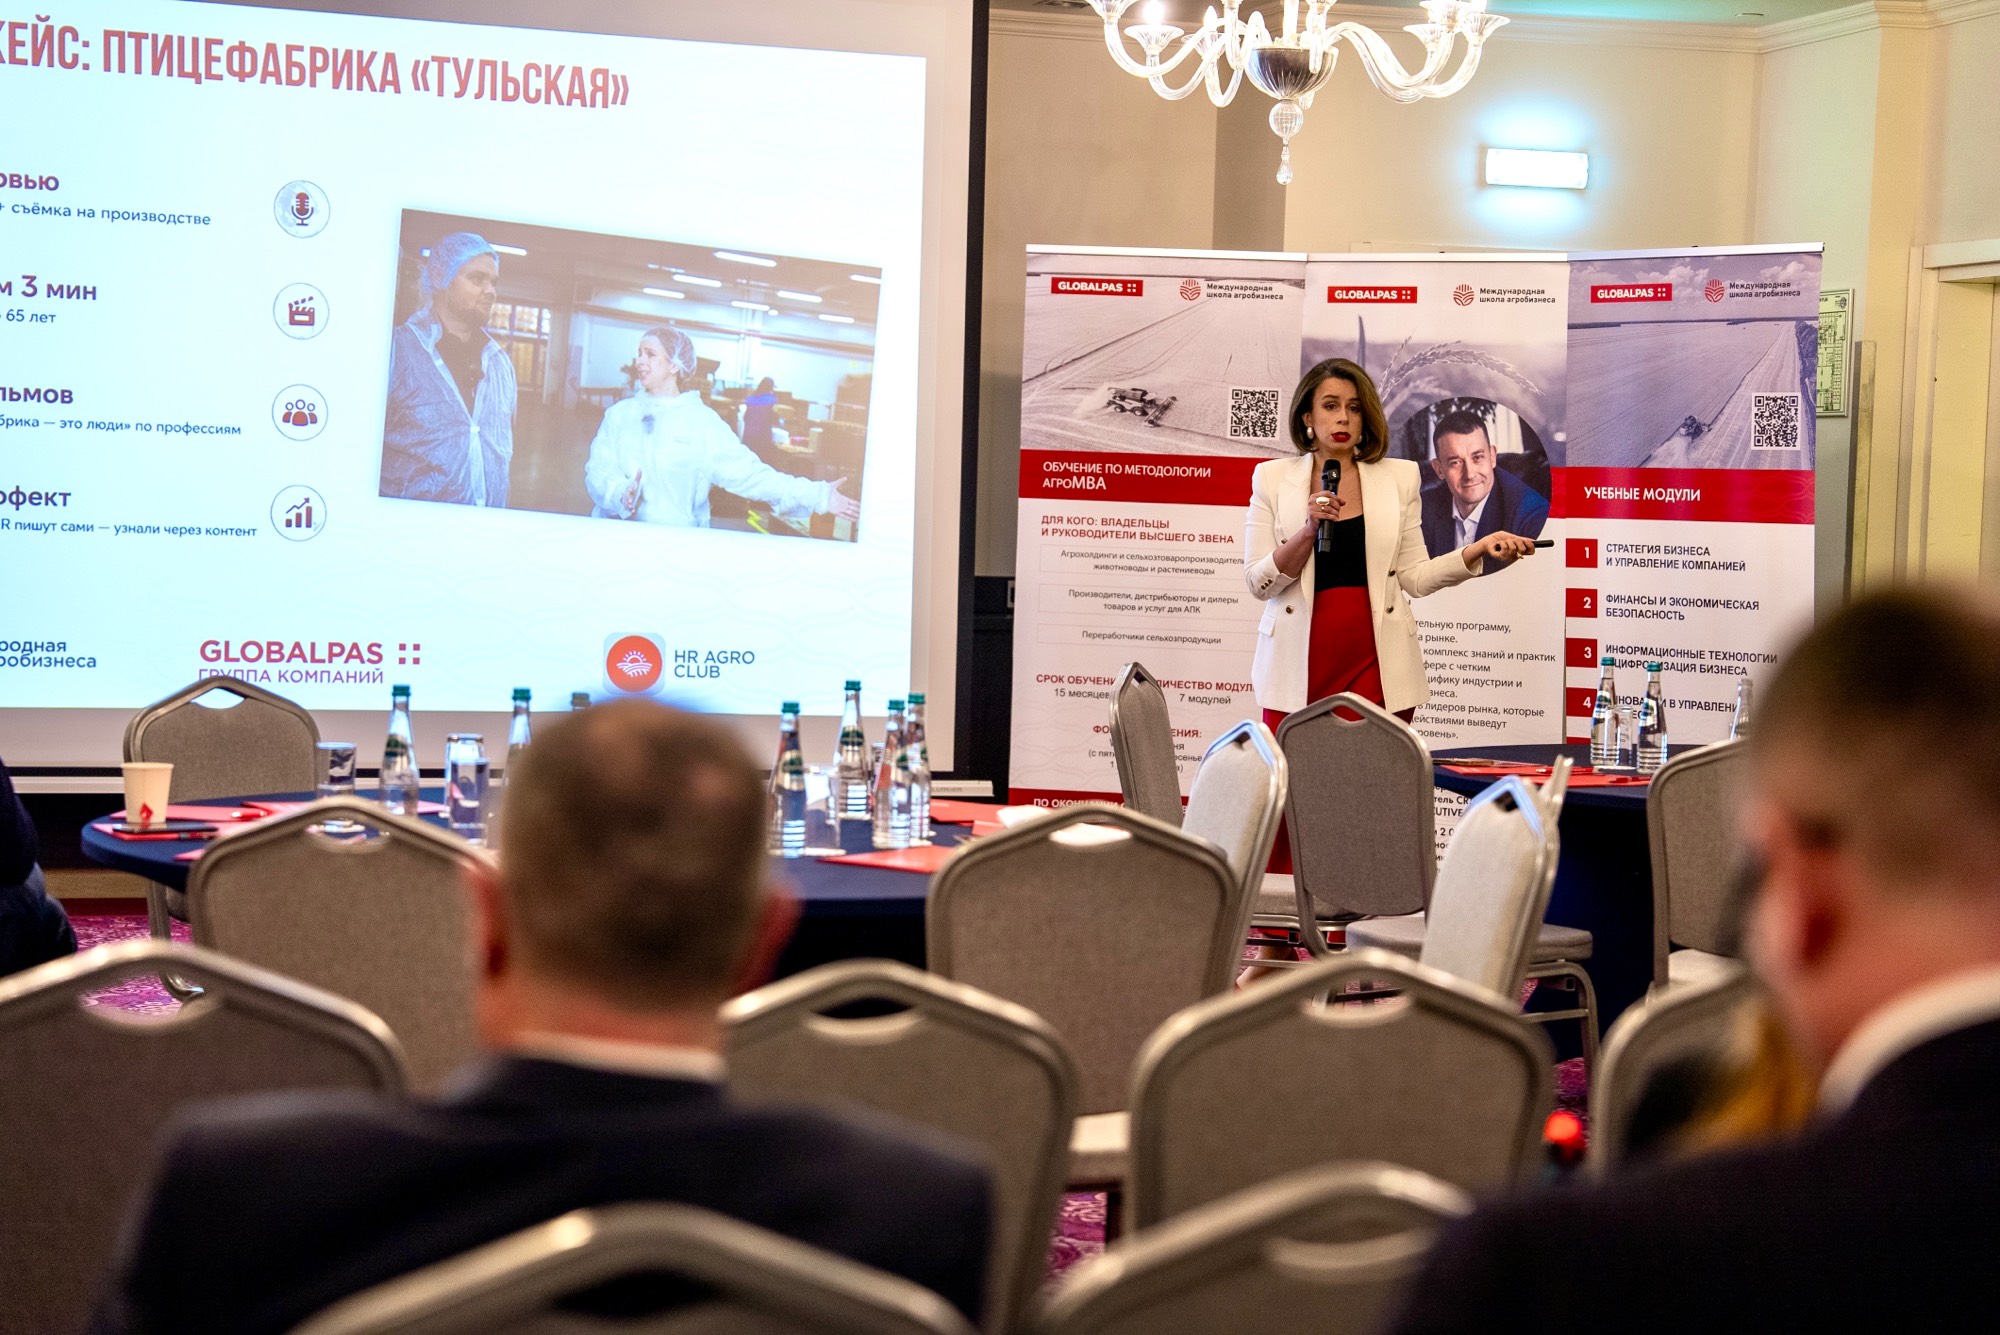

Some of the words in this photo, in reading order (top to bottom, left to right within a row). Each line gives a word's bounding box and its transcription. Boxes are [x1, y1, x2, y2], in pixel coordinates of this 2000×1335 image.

[0, 14, 90, 70] ЕЙС:
[103, 29, 401, 94] ПТИЦЕФАБРИКА
[411, 54, 630, 109] «ТУЛЬСКАЯ»
[11, 202, 72, 217] съёмка
[77, 207, 95, 218] на
[101, 210, 211, 225] производстве
[21, 274, 38, 297] 3
[46, 283, 97, 300] мин
[1057, 281, 1124, 293] GLOBALPAS
[1206, 283, 1273, 292] Международная
[1479, 287, 1545, 296] Международная
[1729, 281, 1791, 290] Международная
[1206, 291, 1232, 299] школа
[1234, 291, 1283, 300] агробизнеса
[1334, 290, 1398, 300] GLOBALPAS
[1507, 295, 1556, 304] агробизнеса
[1597, 288, 1654, 299] GLOBALPAS
[1754, 289, 1800, 298] агробизнеса
[6, 309, 25, 322] 65
[29, 313, 56, 323] лет
[59, 418, 83, 429] это
[86, 420, 131, 432] люди»
[135, 422, 152, 432] по
[156, 422, 241, 436] профессиям
[1042, 461, 1102, 474] ОБУЧЕНИЕ
[1105, 463, 1122, 474] ПО
[1124, 465, 1211, 478] МЕТОДОЛОГИИ
[1584, 486, 1640, 500] УЧЕБНЫЕ
[1643, 488, 1701, 503] МОДУЛИ
[1041, 515, 1063, 526] ДЛЯ
[1066, 516, 1098, 526] КОГО:
[1101, 518, 1169, 529] ВЛАДЕЛЬЦЫ
[15, 521, 56, 534] пишут
[61, 522, 94, 533] сами
[114, 524, 160, 536] узнали
[164, 525, 201, 537] через
[205, 525, 257, 537] контент
[1041, 528, 1048, 536] И
[1052, 529, 1136, 540] РУКОВОДИТЕЛИ
[1140, 532, 1195, 542] ВЫСШЕГО
[1198, 534, 1234, 544] ЗВЕНА
[1061, 550, 1117, 561] Агрохолдинги
[1584, 547, 1590, 559] 1
[1606, 543, 1661, 555] СТРАТЕГИЯ
[1663, 545, 1711, 556] БИЗНЕСА
[1093, 564, 1148, 573] животноводы
[1157, 566, 1215, 576] растениеводы
[1606, 558, 1613, 567] И
[1615, 558, 1679, 570] УПРАВЛЕНИЕ
[1682, 559, 1746, 571] КОМПАНИЕЙ
[1068, 589, 1133, 600] Производители,
[1134, 593, 1199, 603] дистрибьюторы
[1207, 596, 1239, 605] дилеры
[1583, 597, 1591, 609] 2
[1605, 594, 1657, 605] ФИНАНСЫ
[1659, 596, 1667, 605] И
[1669, 597, 1759, 611] ЭКОНОМИЧЕСКАЯ
[1104, 603, 1136, 612] товаров
[1144, 605, 1166, 614] услуг
[1167, 606, 1182, 614] для
[1184, 605, 1201, 613] АПК
[1605, 607, 1685, 620] БЕЗОПАСНОСТЬ
[1456, 622, 1511, 634] программу,
[1082, 630, 1144, 641] Переработчики
[1146, 633, 1221, 644] сельхозпродукции
[1425, 635, 1458, 644] рынке.
[199, 639, 384, 665] GLOBALPAS
[674, 649, 698, 664] HR
[704, 650, 755, 665] AGRO
[1423, 648, 1468, 658] комплекс
[1471, 650, 1505, 660] знаний
[1516, 653, 1556, 663] практик
[1583, 647, 1592, 658] 3
[1605, 644, 1705, 660] ИНФОРМАЦИОННЫЕ
[1708, 650, 1778, 664] ТЕХНОЛОГИИ
[674, 664, 720, 679] CLUB
[1456, 664, 1491, 672] четким
[1700, 664, 1748, 676] БИЗНЕСА
[278, 667, 383, 684] КОМПАНИЙ
[1036, 674, 1064, 683] СРОК
[1216, 682, 1255, 692] МОДУЛ
[1462, 677, 1513, 689] индустрии
[1054, 688, 1066, 697] 15
[1069, 690, 1109, 699] месяцев
[1180, 693, 1185, 702] 7
[1188, 695, 1231, 705] модулей
[1583, 697, 1592, 708] 4
[1669, 700, 1676, 709] В
[1425, 702, 1466, 713] лидеров
[1468, 705, 1501, 716] рынка,
[1503, 708, 1545, 718] которые
[1411, 715, 1464, 726] ействиями
[1467, 719, 1507, 730] выведут
